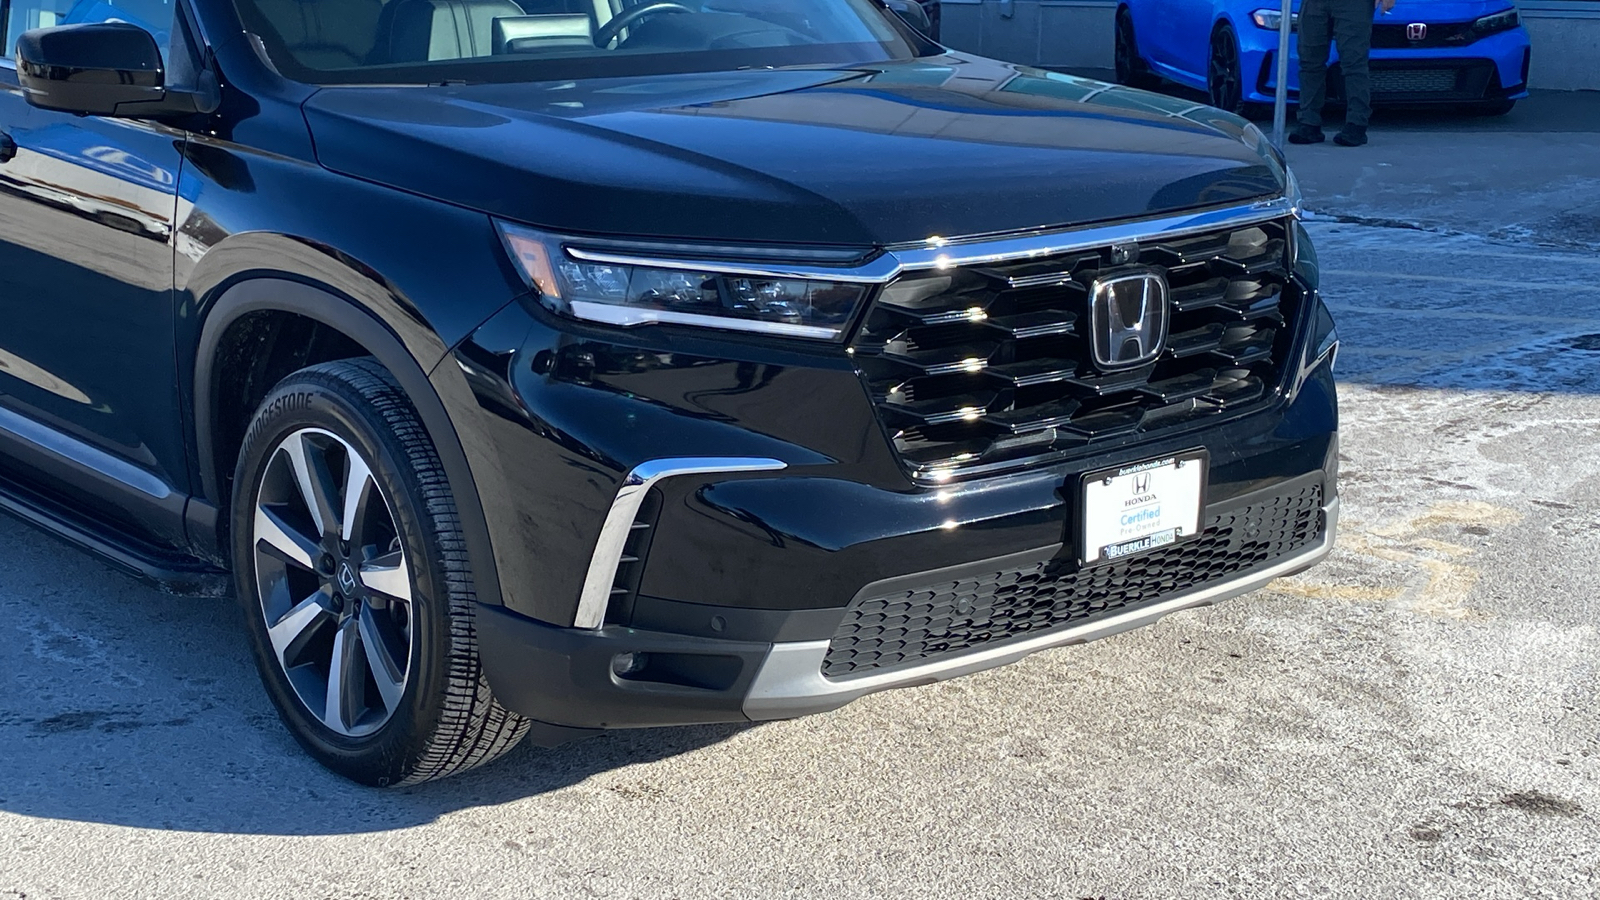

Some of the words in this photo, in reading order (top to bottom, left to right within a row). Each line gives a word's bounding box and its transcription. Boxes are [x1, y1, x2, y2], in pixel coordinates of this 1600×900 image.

[1118, 457, 1175, 476] buerklehonda.com
[1124, 493, 1157, 507] HONDA
[1120, 505, 1161, 526] Certified
[1120, 519, 1160, 536] Pre-Owned
[1110, 538, 1150, 558] BUERKLE
[1151, 533, 1174, 546] HONDA
